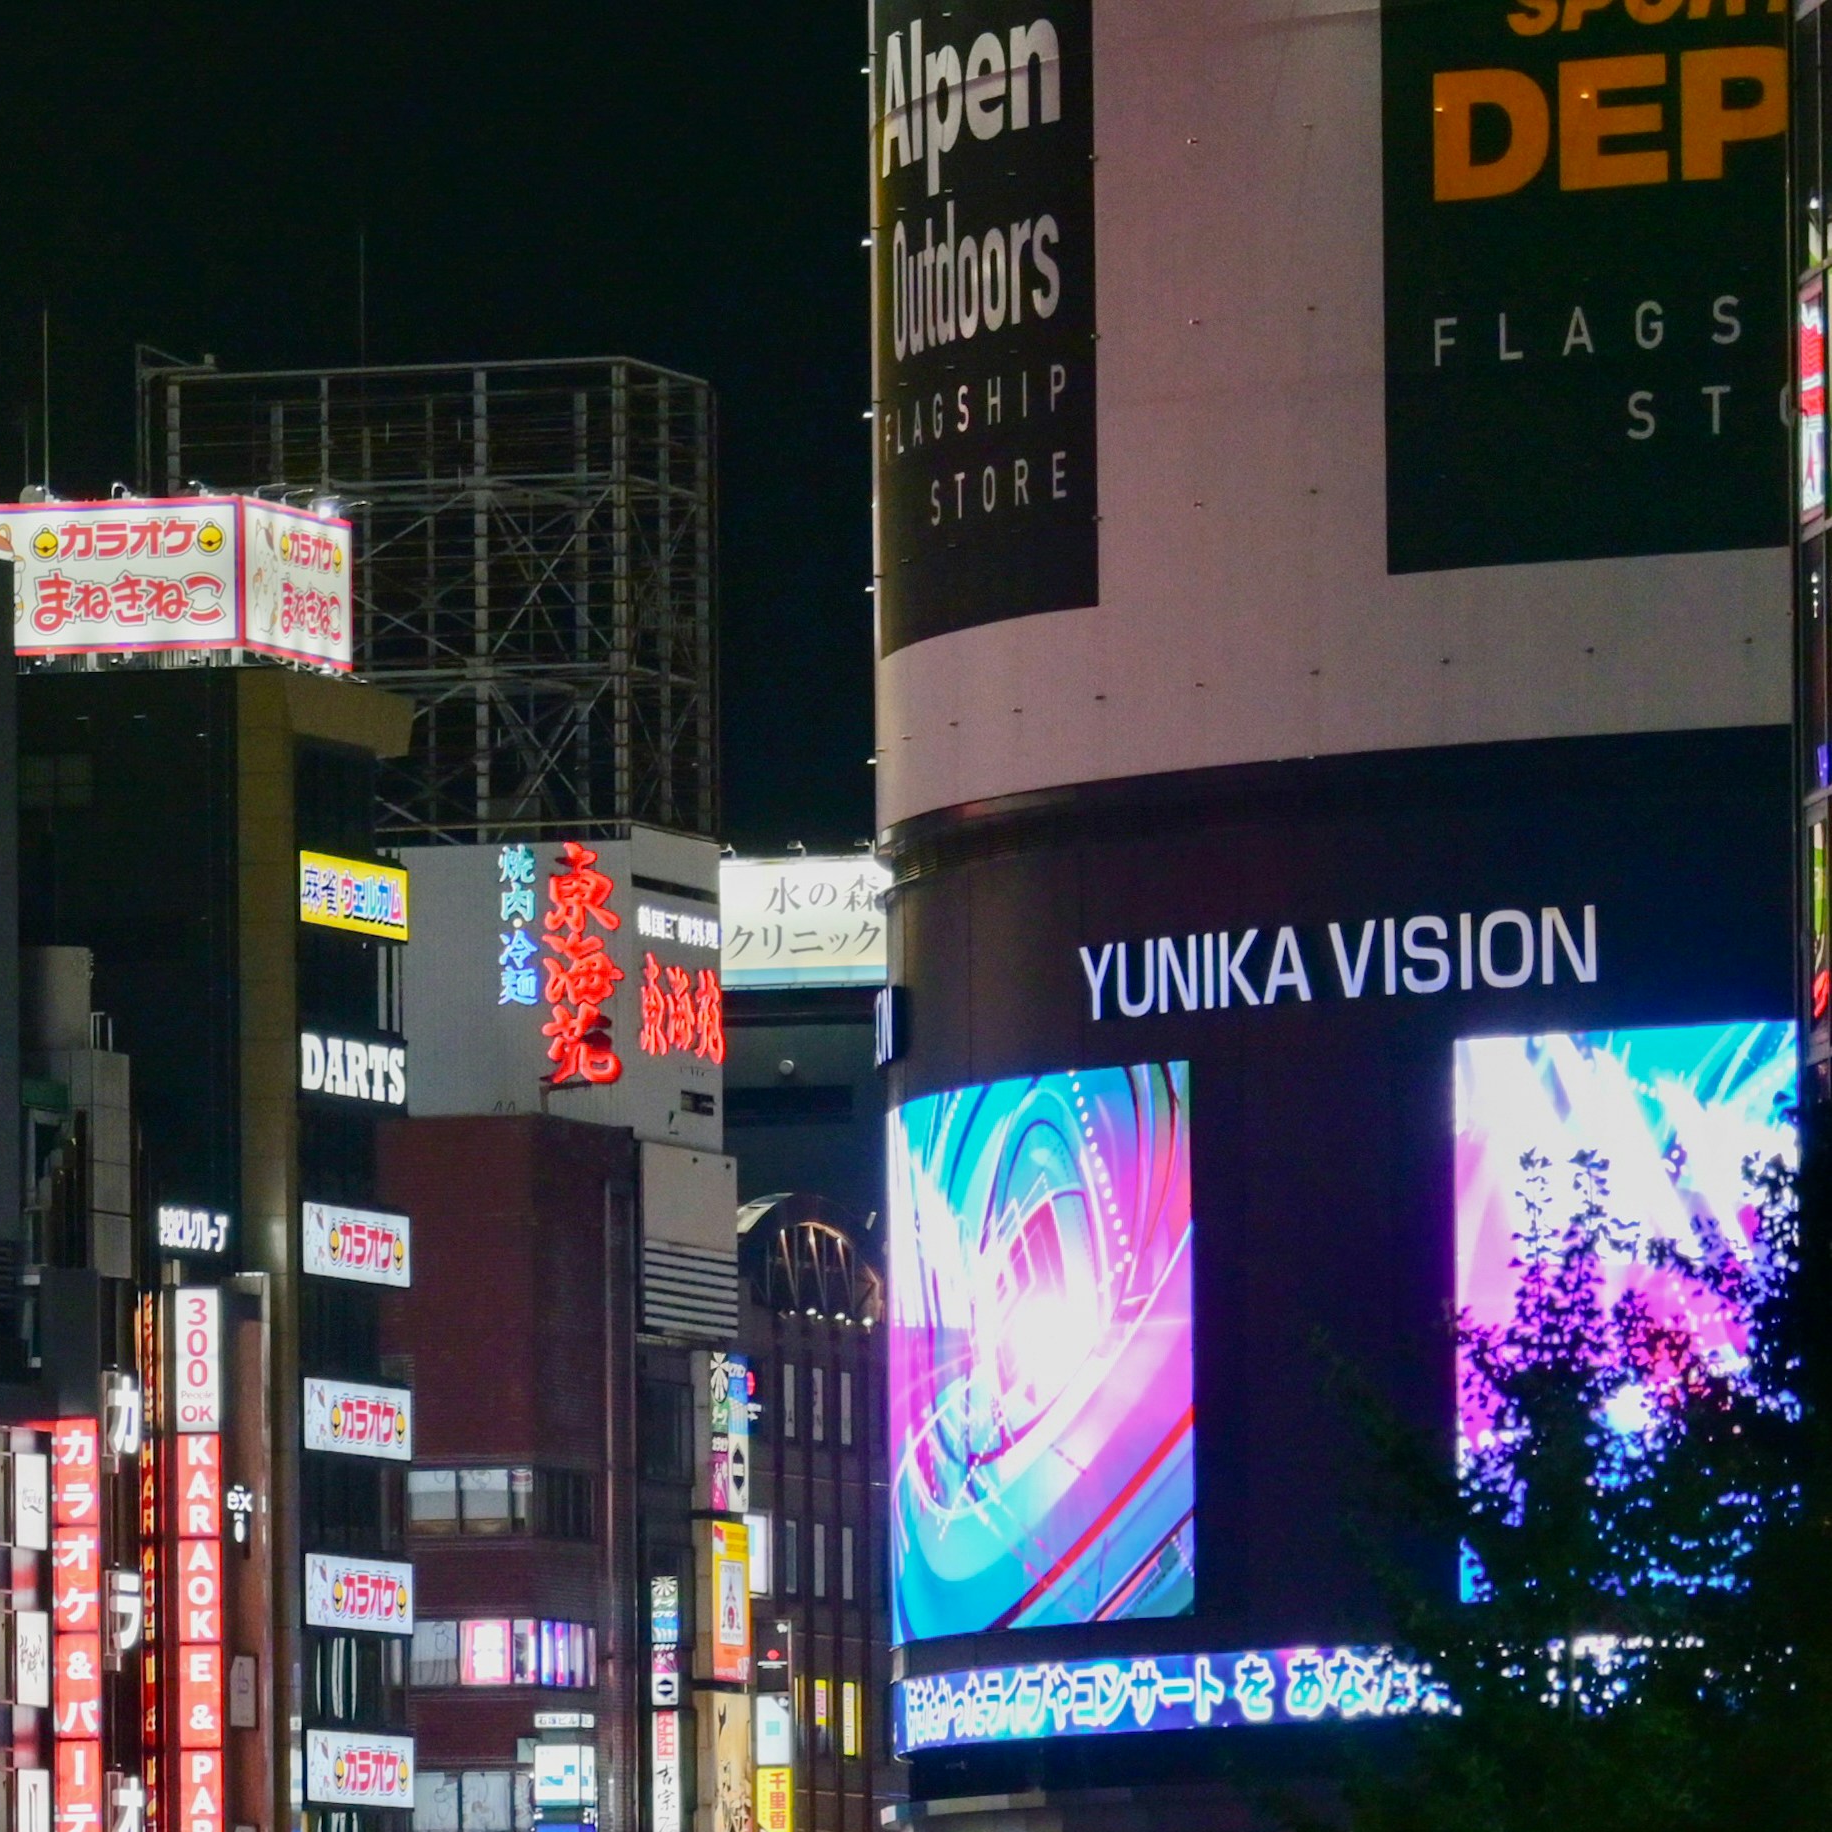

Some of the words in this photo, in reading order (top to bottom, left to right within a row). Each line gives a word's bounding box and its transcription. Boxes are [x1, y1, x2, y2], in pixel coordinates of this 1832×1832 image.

[881, 15, 1062, 195] Alpen
[891, 200, 1062, 366] Outdoors
[883, 362, 1068, 462] FLAGSHIP
[929, 450, 1068, 527] STORE
[55, 518, 201, 562] カラオケ
[279, 526, 335, 575] カラオケ
[29, 569, 227, 638] まねきねこ
[279, 580, 344, 645] まねきねこ
[302, 862, 340, 918] 麻雀
[340, 867, 406, 930] ウェルカム
[762, 873, 884, 914] 水の森
[728, 920, 884, 963] クリニック
[1079, 925, 1311, 1021] YUNIKA
[1329, 903, 1598, 998] VISION
[300, 1030, 408, 1107] DARTS
[337, 1219, 395, 1273] カラオケ
[187, 1298, 208, 1389] 300
[180, 1404, 215, 1424] OK
[339, 1395, 397, 1447] カラオケ
[187, 1437, 217, 1683] KARAOKE
[341, 1569, 399, 1622] カラオケ
[191, 1703, 216, 1730] &
[1234, 1655, 1274, 1720] を
[343, 1744, 401, 1796] カラオケ
[769, 1771, 787, 1829] 千里香
